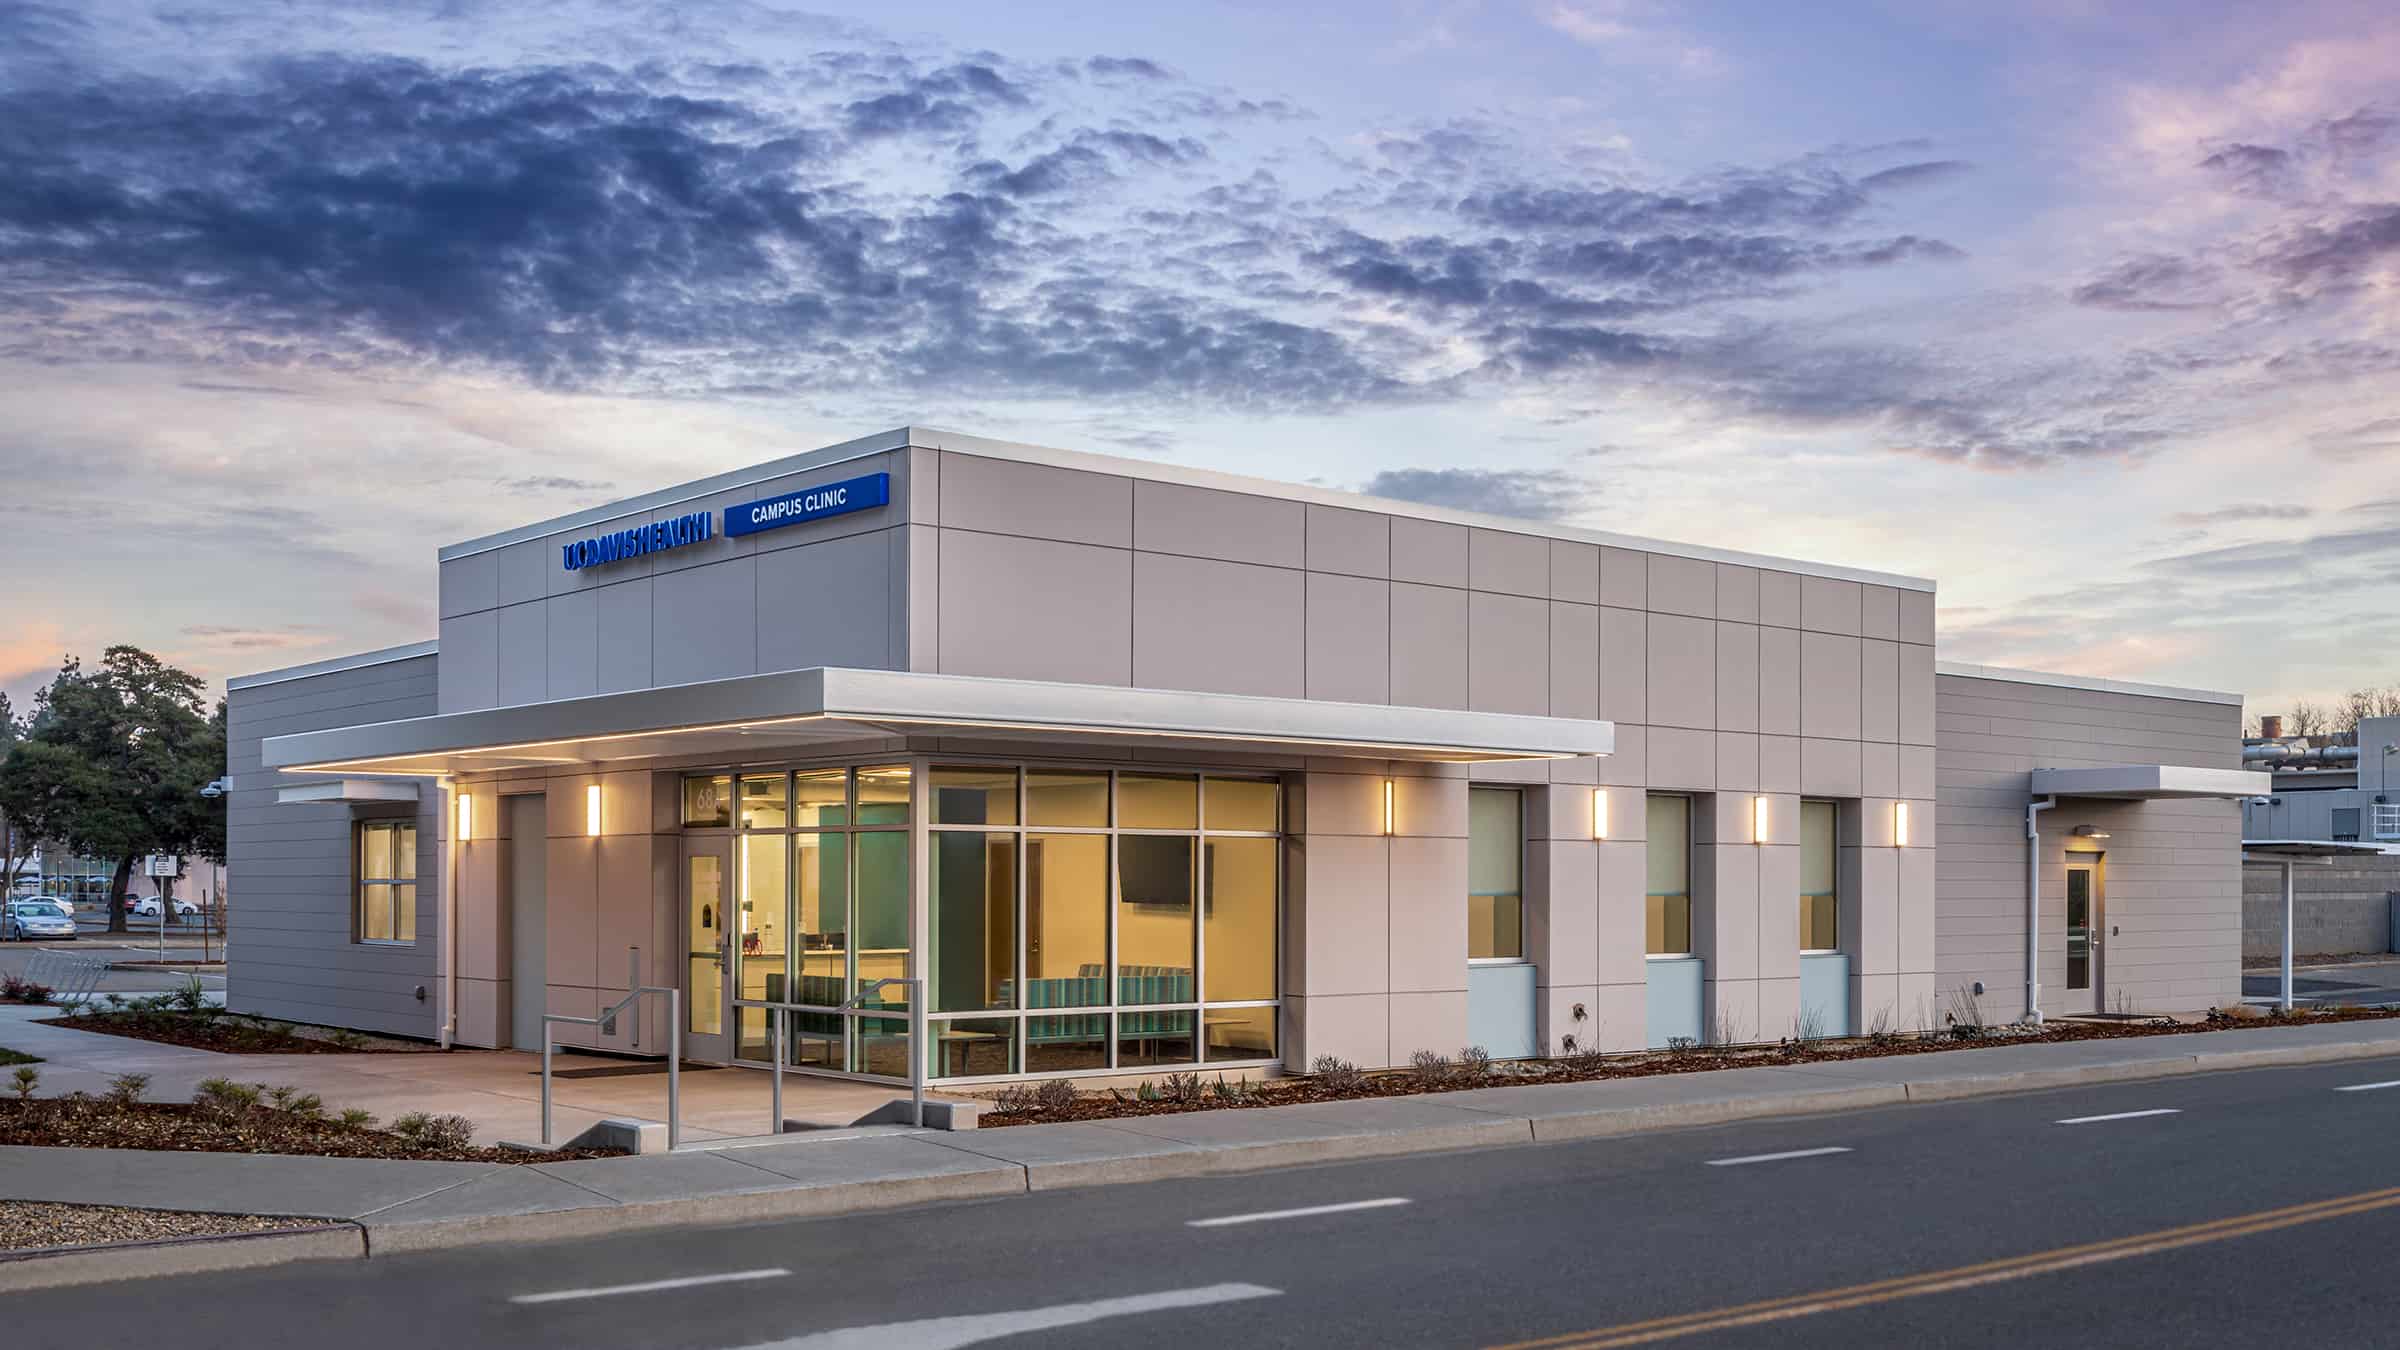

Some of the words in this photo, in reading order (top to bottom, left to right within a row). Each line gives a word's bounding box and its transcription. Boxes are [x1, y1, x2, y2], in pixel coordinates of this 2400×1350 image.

[751, 498, 802, 524] CAMPUS
[805, 487, 847, 512] CLINIC
[639, 511, 712, 555] HEALTH
